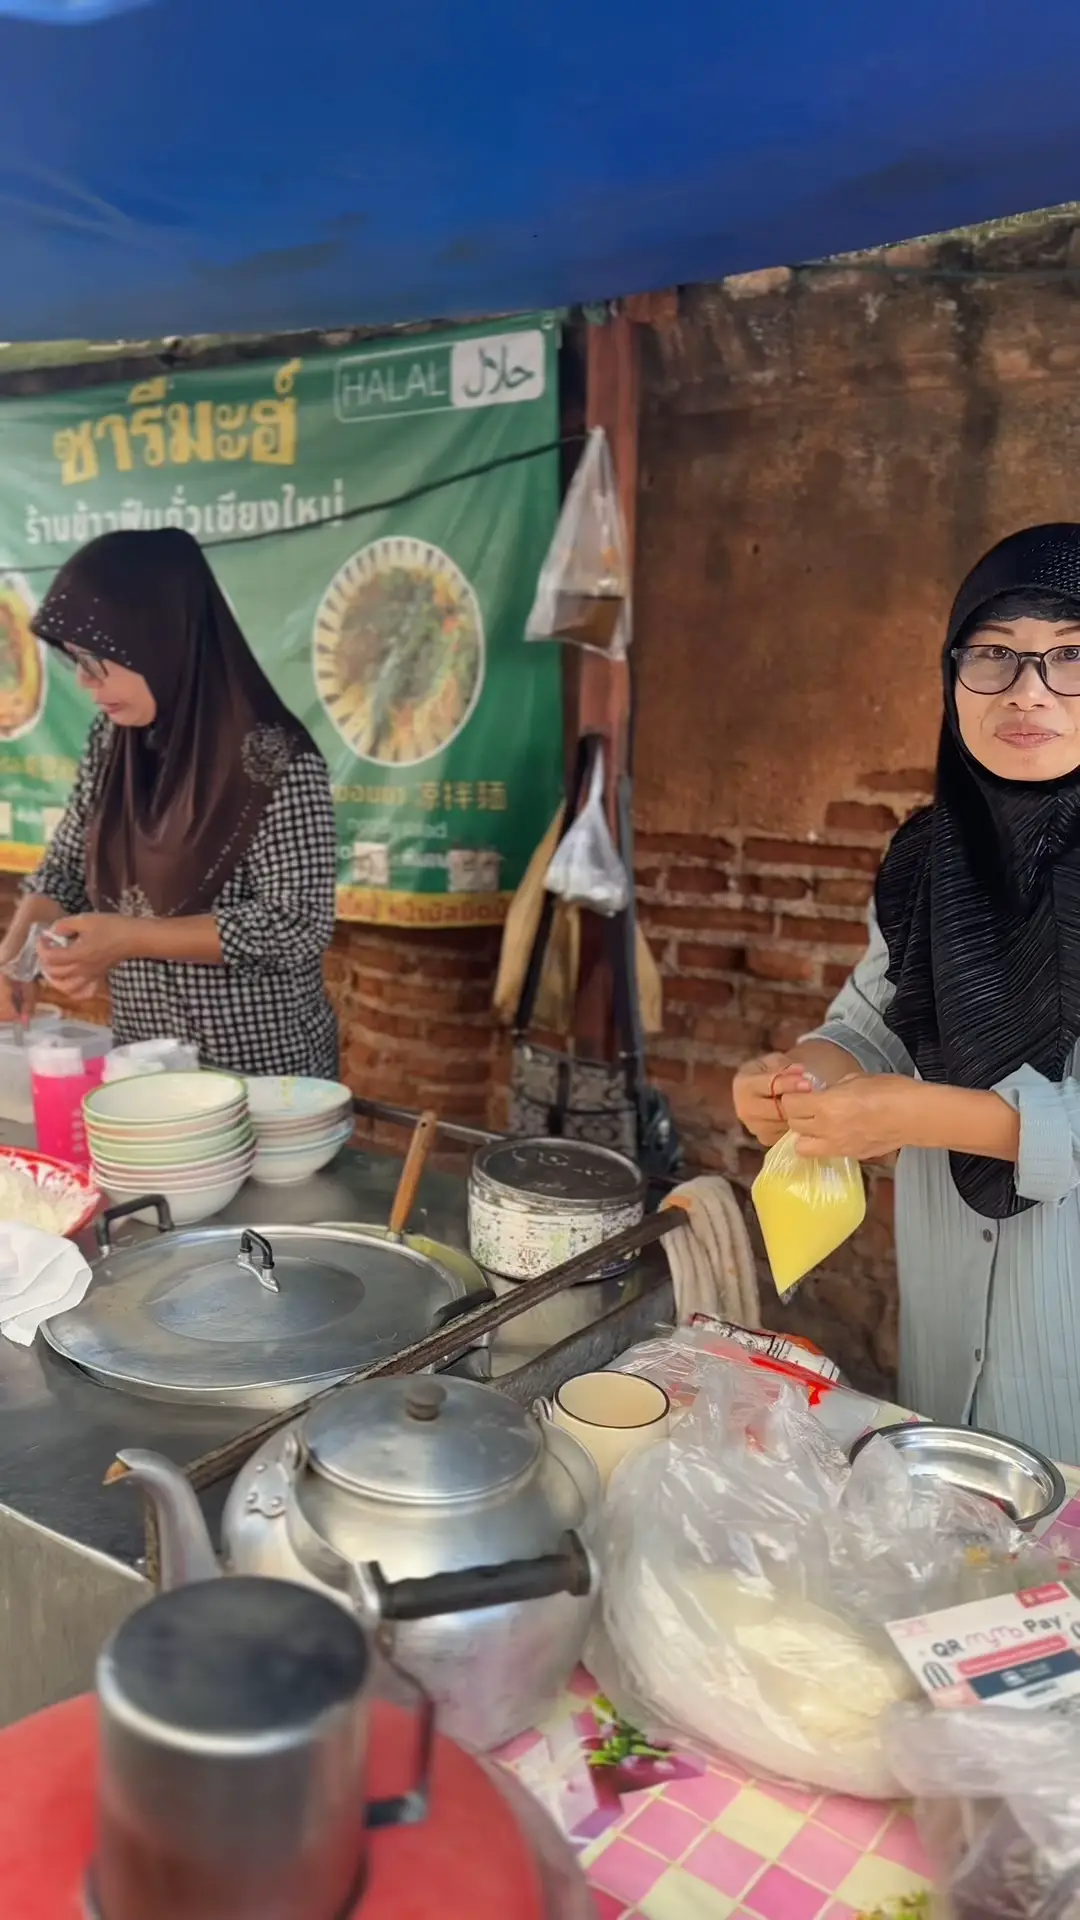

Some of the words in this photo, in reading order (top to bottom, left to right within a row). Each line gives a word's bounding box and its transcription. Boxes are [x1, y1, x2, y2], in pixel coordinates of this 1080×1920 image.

[342, 361, 446, 406] HALAL
[461, 346, 535, 398] حلال
[931, 1638, 964, 1657] QR
[1023, 1614, 1061, 1633] Pay
